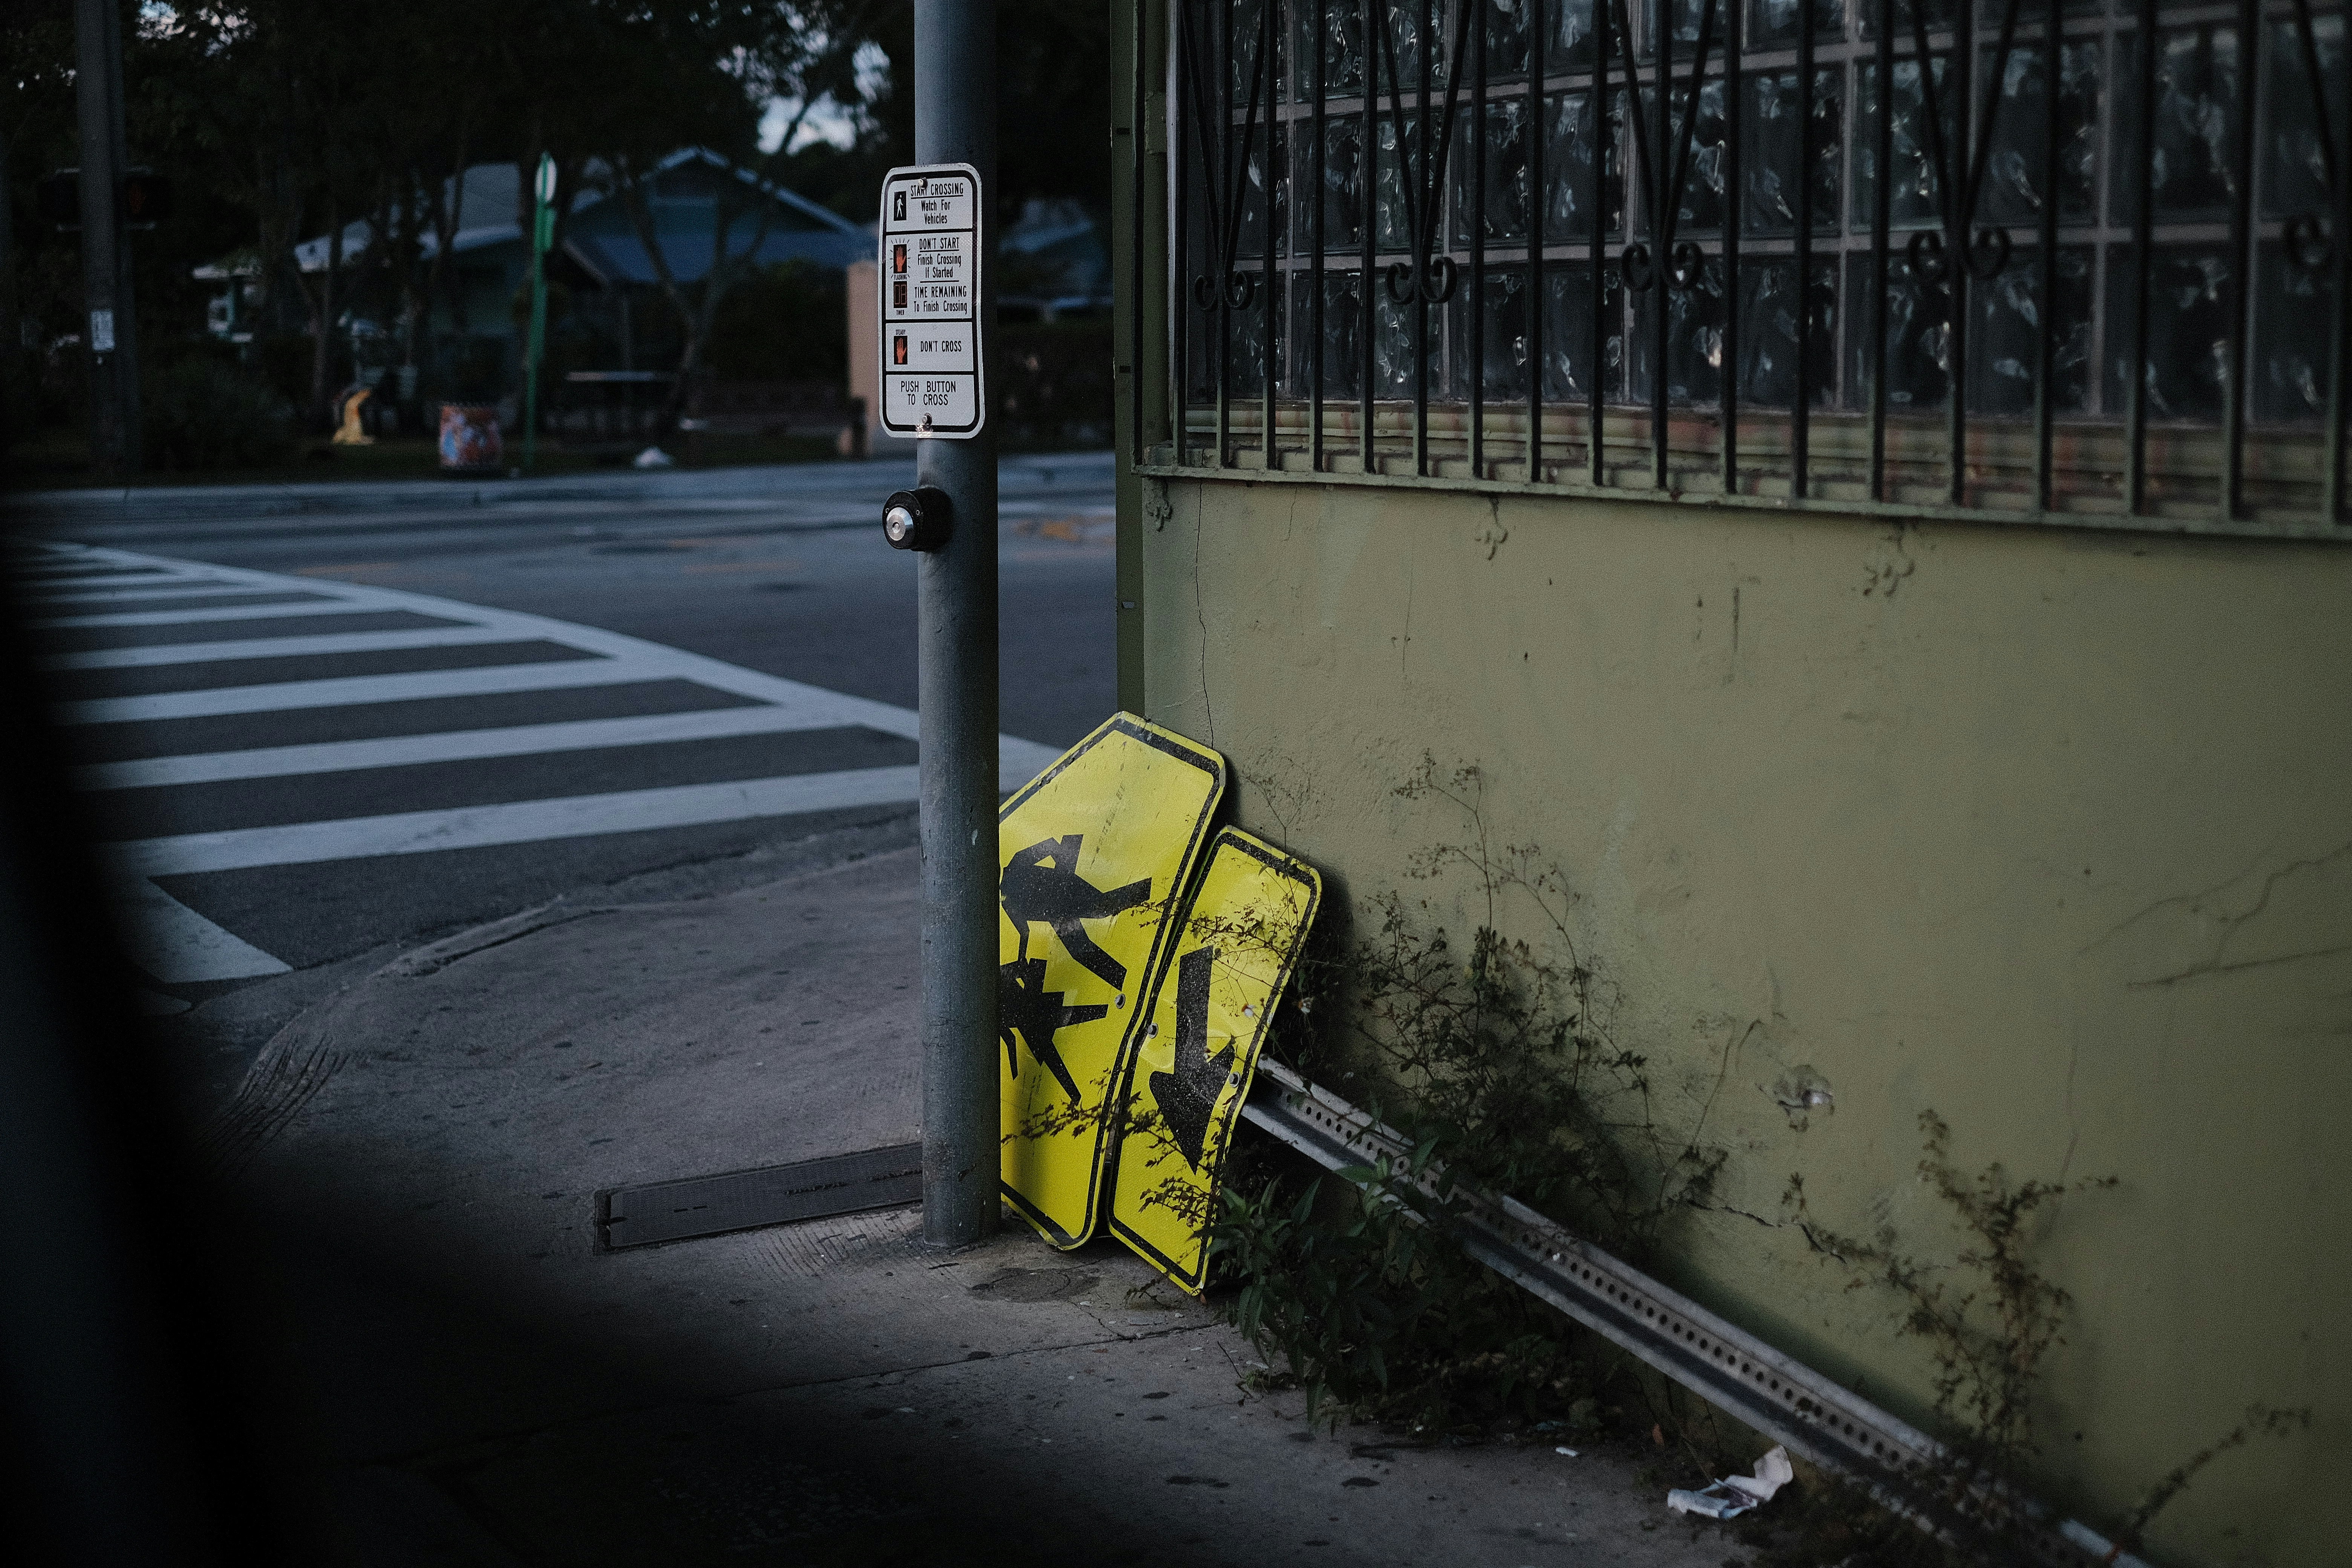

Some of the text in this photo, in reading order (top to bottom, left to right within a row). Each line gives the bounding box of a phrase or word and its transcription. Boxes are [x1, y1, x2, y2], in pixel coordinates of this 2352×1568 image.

[931, 182, 963, 195] CROSSING
[921, 199, 951, 211] Watch For
[924, 213, 948, 224] Vehicles
[919, 237, 959, 250] DON'T START
[917, 253, 962, 267] Finish Crossing
[925, 266, 953, 278] If Started
[914, 285, 967, 298] TIME REMAINING
[914, 300, 967, 315] To Finish Crossing
[920, 340, 962, 352] DON'T CROSS
[901, 380, 956, 393] PUSH BUTTON
[907, 394, 948, 406] TO CROSS
